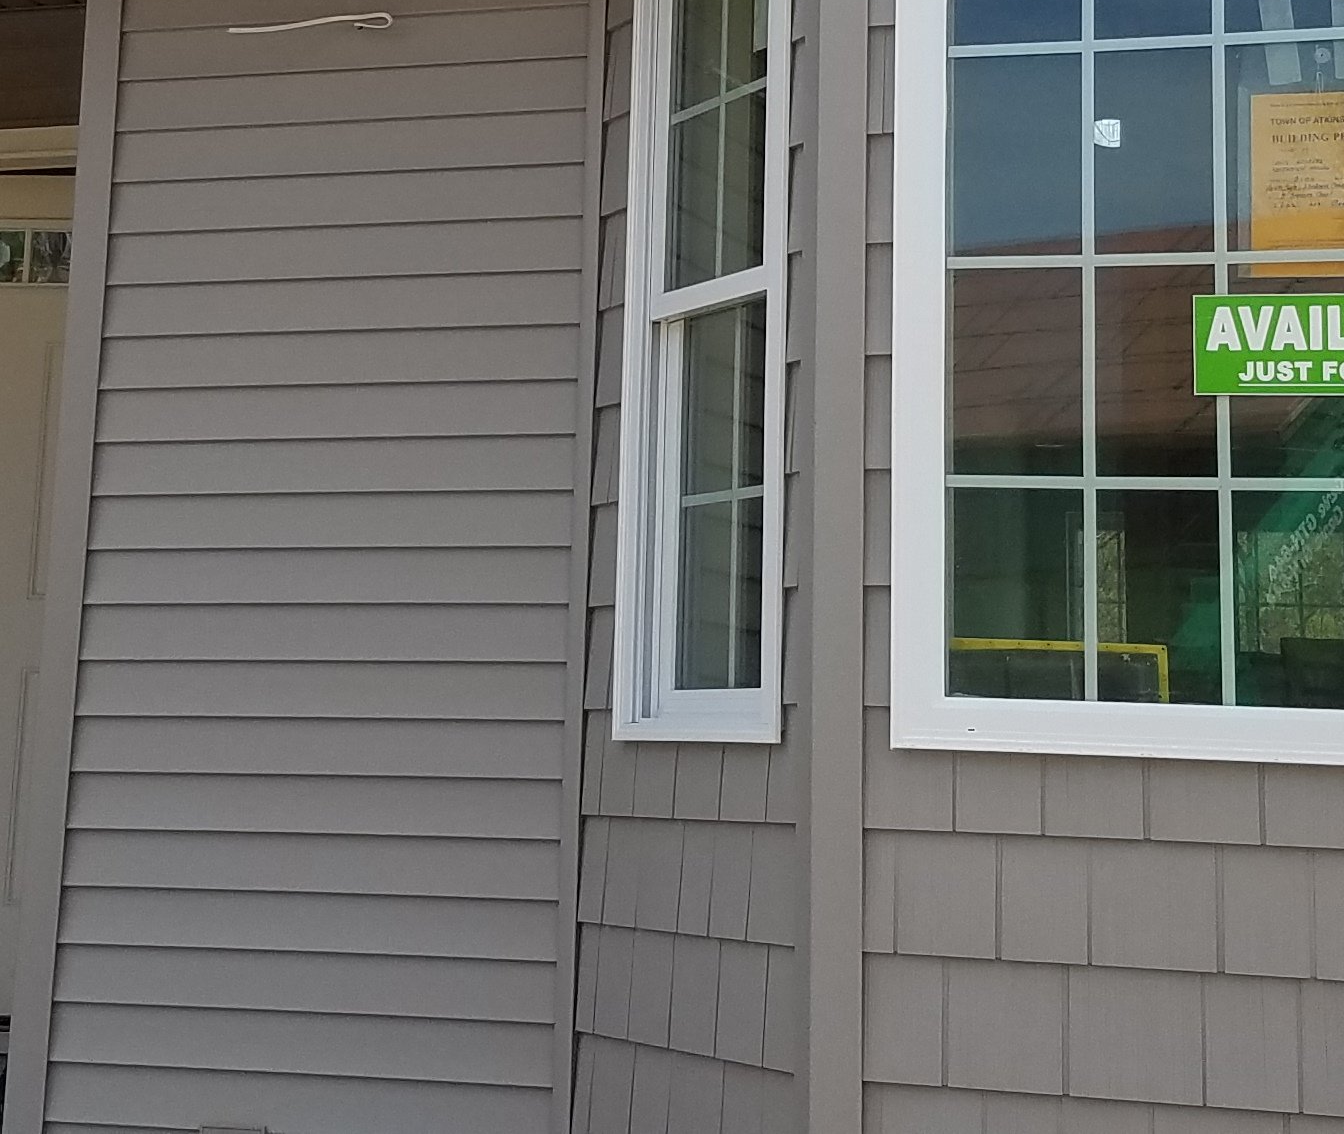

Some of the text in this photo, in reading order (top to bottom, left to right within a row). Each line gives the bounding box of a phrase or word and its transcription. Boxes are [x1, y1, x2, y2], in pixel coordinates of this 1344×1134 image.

[1270, 117, 1296, 126] TOWN
[1299, 117, 1311, 125] OF
[1272, 132, 1329, 144] BUILDING
[1238, 361, 1313, 382] JUST
